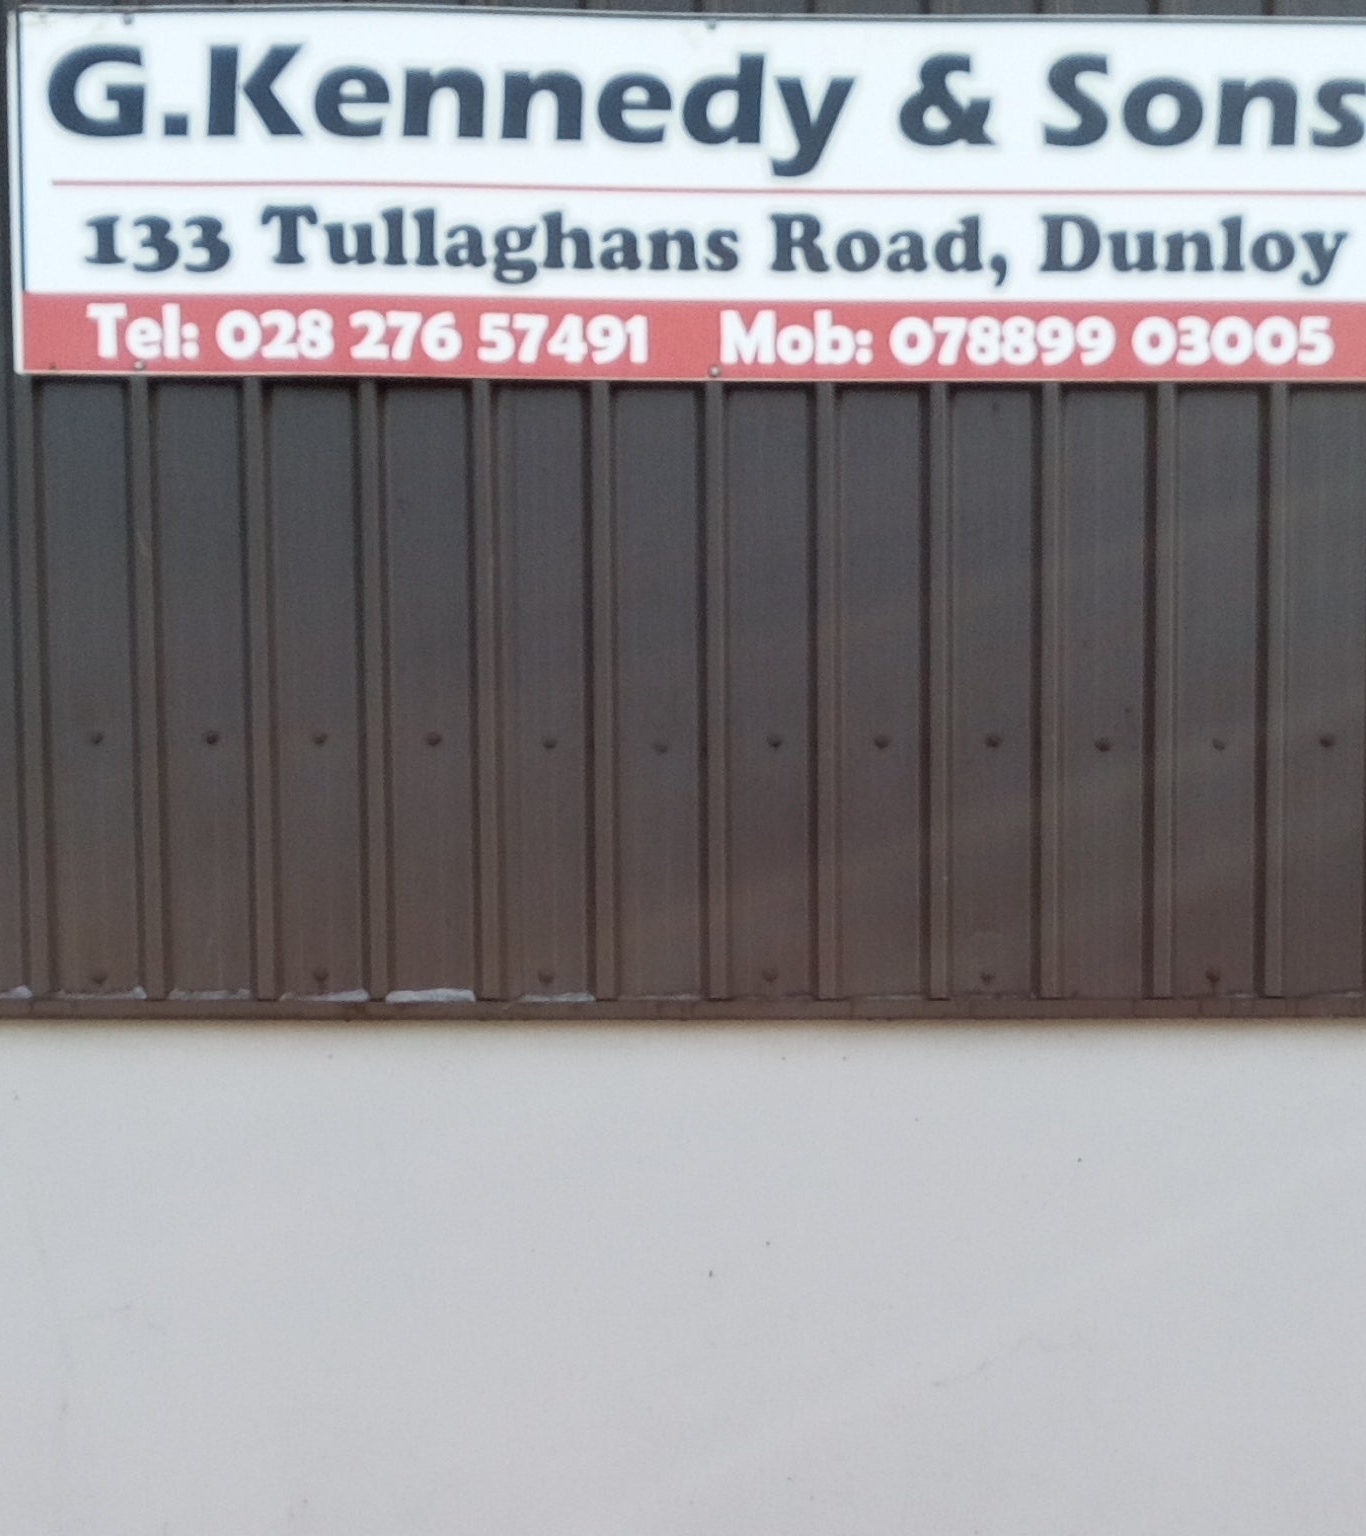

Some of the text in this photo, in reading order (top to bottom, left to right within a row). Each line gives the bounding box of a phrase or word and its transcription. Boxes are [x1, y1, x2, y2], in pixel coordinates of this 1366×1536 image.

[47, 43, 856, 178] G.Kennedy
[898, 52, 997, 147] &
[84, 204, 1349, 287] 133 Tullaghans Road, Dunloy
[86, 302, 1335, 367] Tel: 028 276 57491 Mob: 078899 03005
